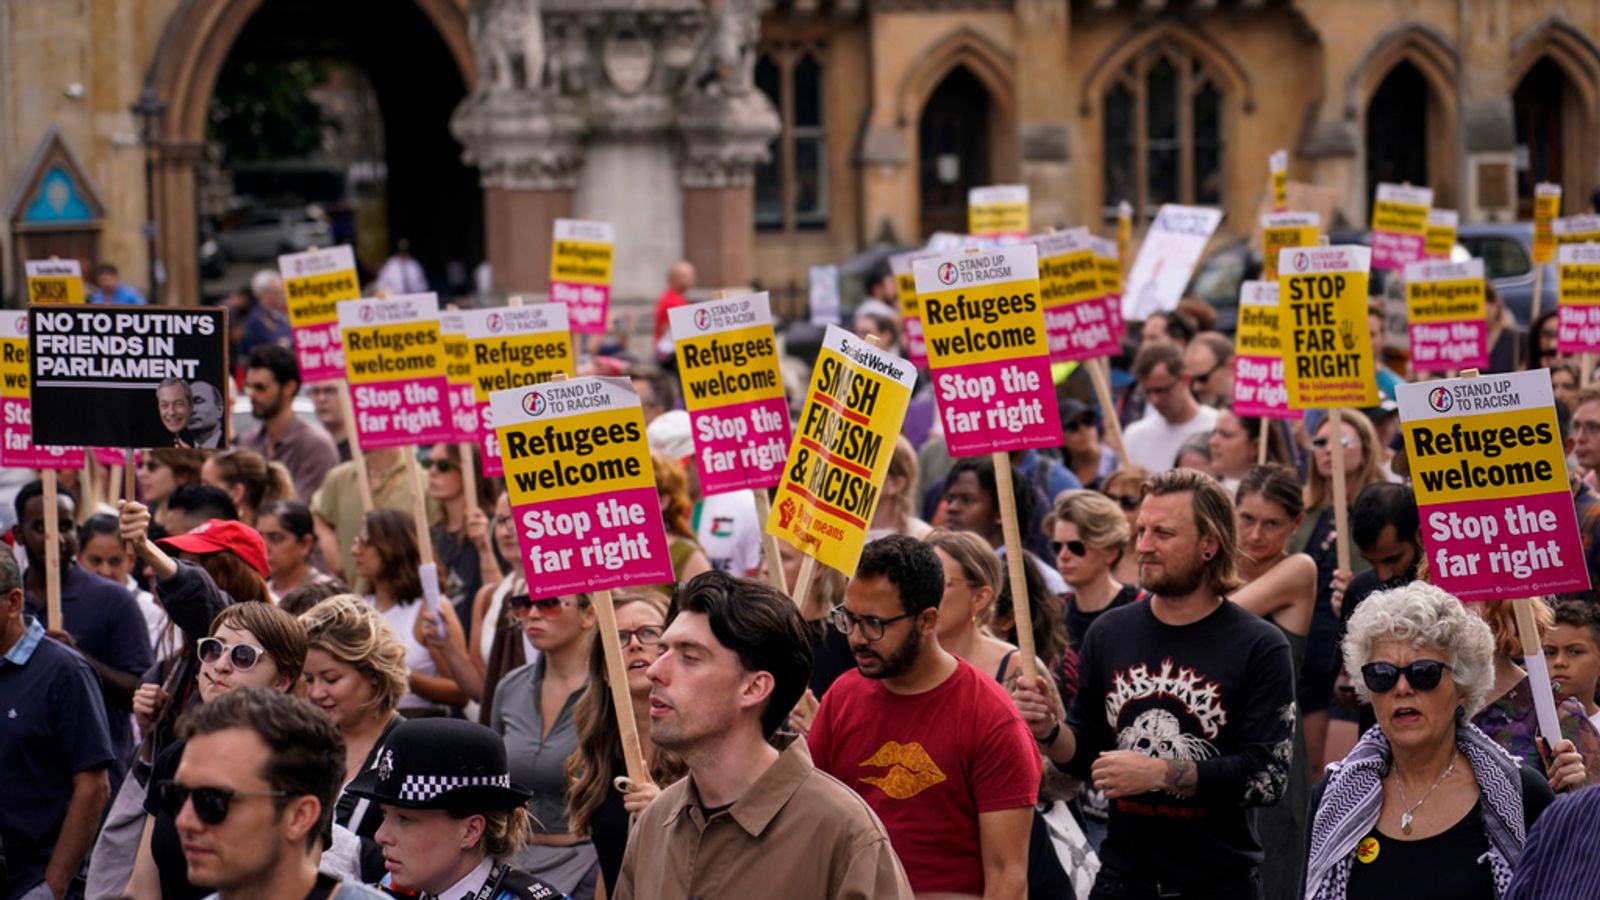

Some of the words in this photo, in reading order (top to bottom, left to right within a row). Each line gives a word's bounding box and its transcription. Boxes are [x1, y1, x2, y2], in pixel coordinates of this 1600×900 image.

[959, 257, 988, 271] STAND
[990, 255, 1005, 267] UP
[961, 271, 974, 283] TO
[976, 266, 1012, 281] RACISM
[288, 276, 353, 298] Refugees
[1289, 276, 1346, 300] STOP
[1411, 284, 1480, 300] Refugees
[925, 292, 1036, 325] Refugees
[1242, 307, 1279, 328] Refug
[1291, 303, 1336, 326] THE
[1413, 302, 1478, 317] welcome
[36, 312, 73, 332] NO
[77, 313, 112, 333] TO
[116, 314, 215, 335] PUTIN'S
[1413, 325, 1449, 343] Stop
[1452, 323, 1478, 340] the
[36, 335, 143, 355] FRIENDS
[148, 337, 174, 356] IN
[347, 329, 437, 351] Refugees
[931, 325, 1036, 357] welcome
[1293, 329, 1336, 352] FAR
[1413, 344, 1437, 360] far
[1440, 341, 1479, 363] right
[352, 354, 436, 374] welcome
[475, 341, 567, 366] Refugees
[683, 337, 774, 369] Refugees
[37, 357, 199, 378] PARLIAMENT
[1236, 358, 1269, 381] Stop
[1297, 354, 1361, 378] RIGHT
[547, 387, 584, 401] STAND
[588, 383, 602, 394] UP
[690, 369, 776, 399] welcome
[818, 357, 880, 416] SMASH
[939, 371, 997, 403] Stop
[1001, 366, 1040, 393] the
[1235, 382, 1257, 401] far
[1454, 383, 1492, 398] STAND
[1495, 381, 1511, 393] UP
[355, 385, 401, 411] Stop
[404, 382, 439, 403] the
[550, 401, 564, 413] TO
[567, 395, 610, 410] RACISM
[1456, 399, 1472, 411] TO
[1474, 393, 1520, 410] RACISM
[358, 412, 389, 433] far
[393, 407, 442, 433] right
[696, 413, 748, 443] Stop
[751, 407, 782, 432] the
[945, 405, 981, 433] far
[986, 398, 1044, 432] right
[507, 422, 640, 459] Refugees
[803, 402, 883, 469] FASCISM
[1412, 422, 1553, 457] Refugees
[702, 447, 737, 474] far
[741, 437, 788, 471] right
[515, 457, 640, 492] welcome
[790, 448, 809, 484] &
[809, 456, 877, 519] RACISM
[1420, 459, 1553, 492] welcome
[523, 510, 590, 540] Stop
[597, 499, 645, 528] the
[1428, 511, 1499, 545] Stop
[1504, 504, 1557, 535] the
[530, 546, 573, 574] far
[581, 533, 651, 570] right
[1436, 548, 1480, 578] far
[1488, 540, 1564, 579] right
